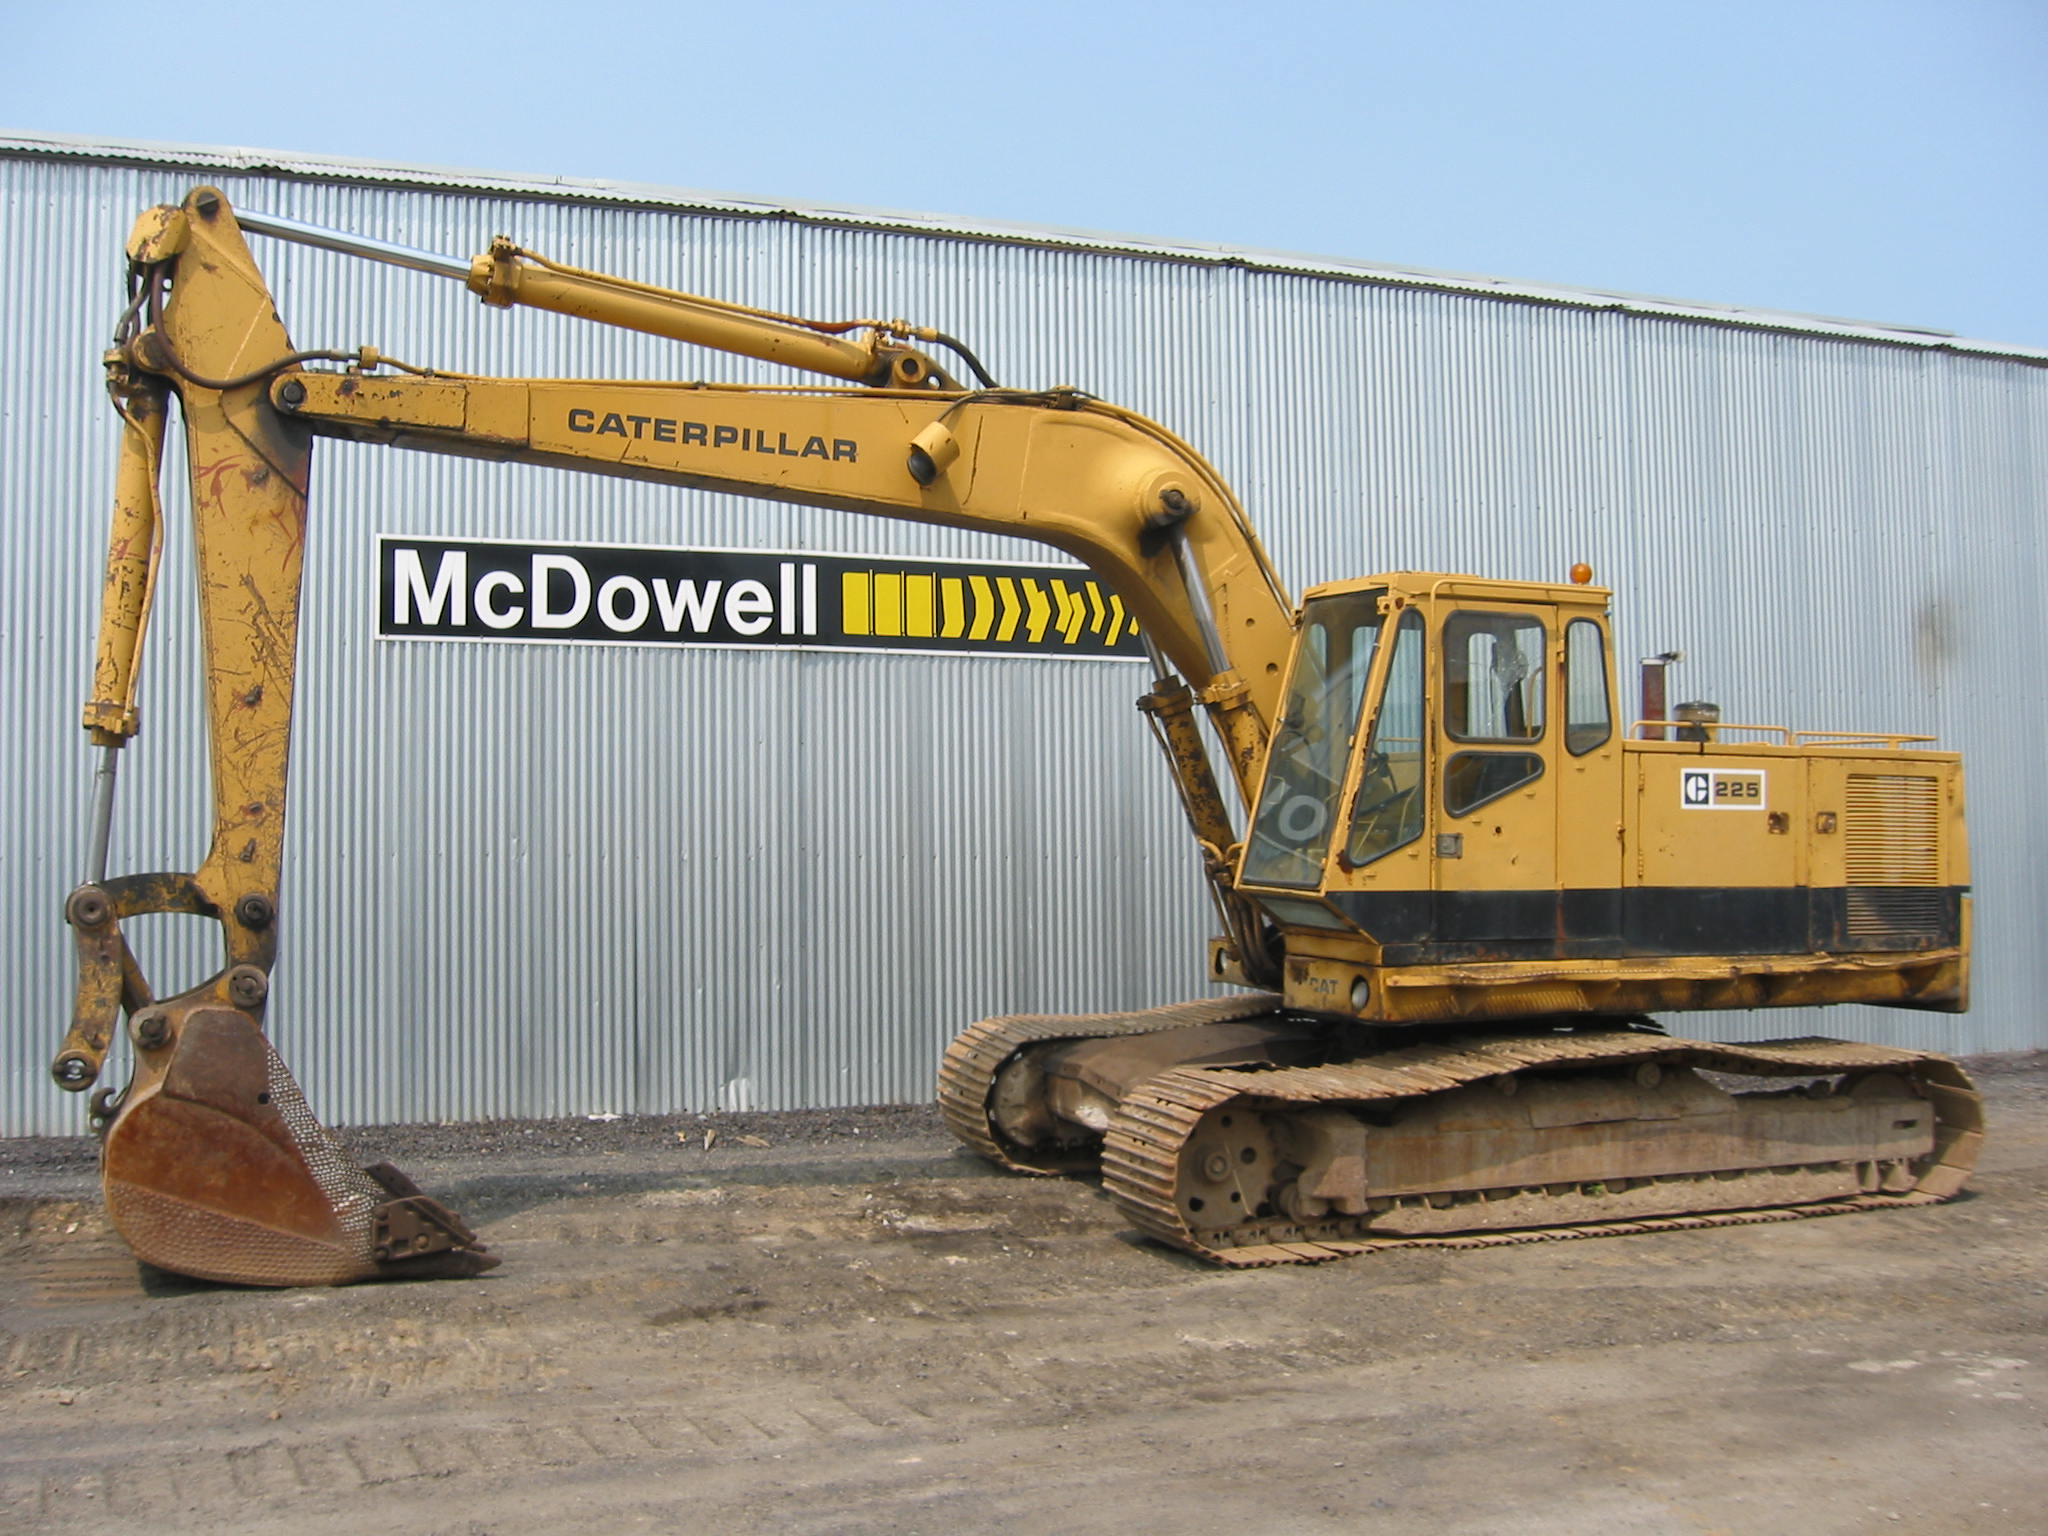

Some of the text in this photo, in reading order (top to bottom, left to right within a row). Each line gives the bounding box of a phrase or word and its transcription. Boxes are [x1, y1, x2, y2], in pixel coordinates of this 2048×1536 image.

[569, 409, 858, 463] CATERPILLAR
[393, 549, 818, 636] McDowell
[1715, 781, 1759, 798] 225
